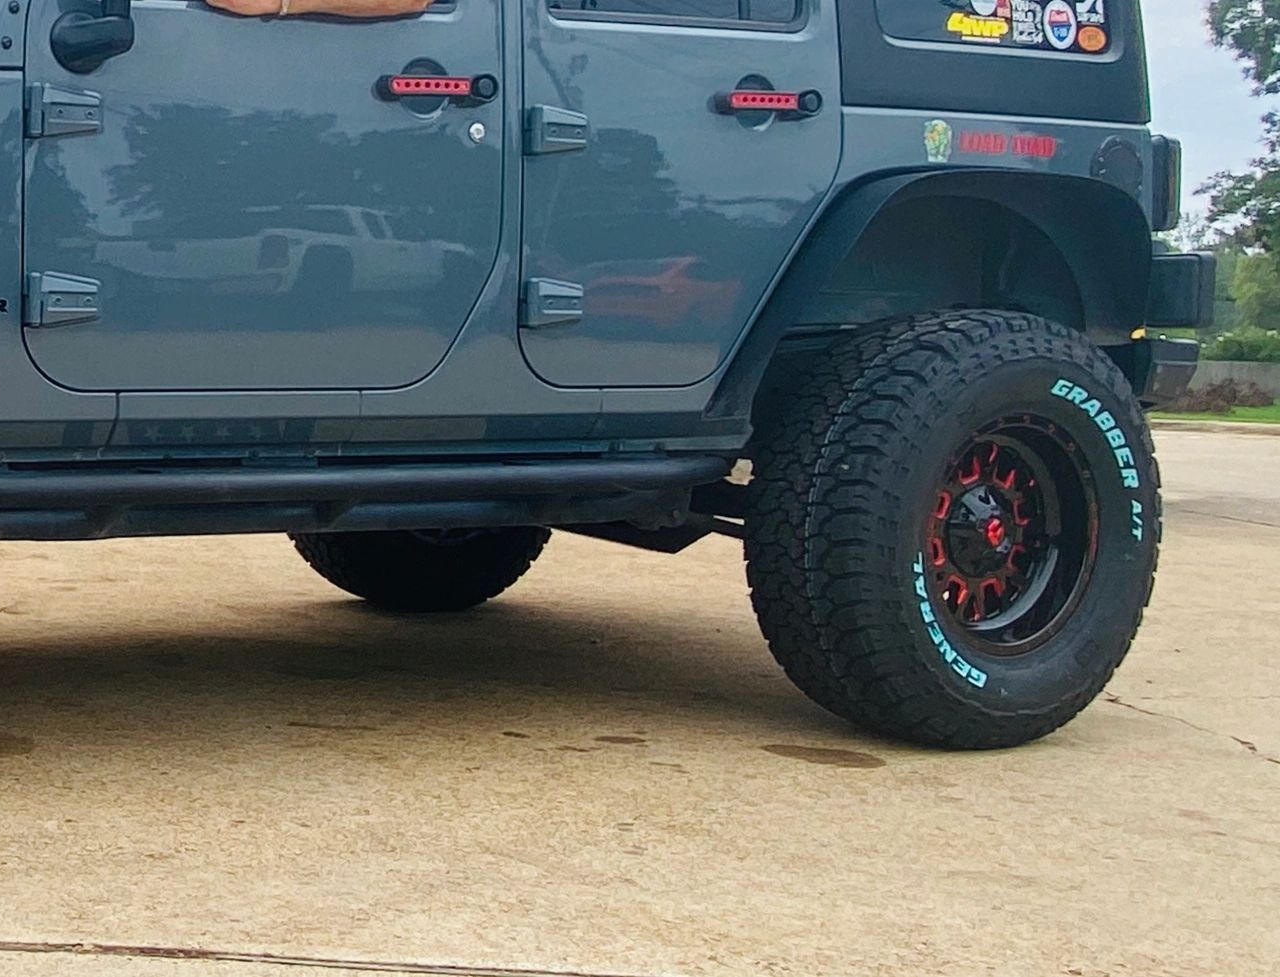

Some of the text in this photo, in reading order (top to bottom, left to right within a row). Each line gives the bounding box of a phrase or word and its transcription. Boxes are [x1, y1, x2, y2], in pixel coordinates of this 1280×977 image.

[1051, 379, 1144, 542] GRABBER A/T
[913, 552, 988, 689] GENERAL
